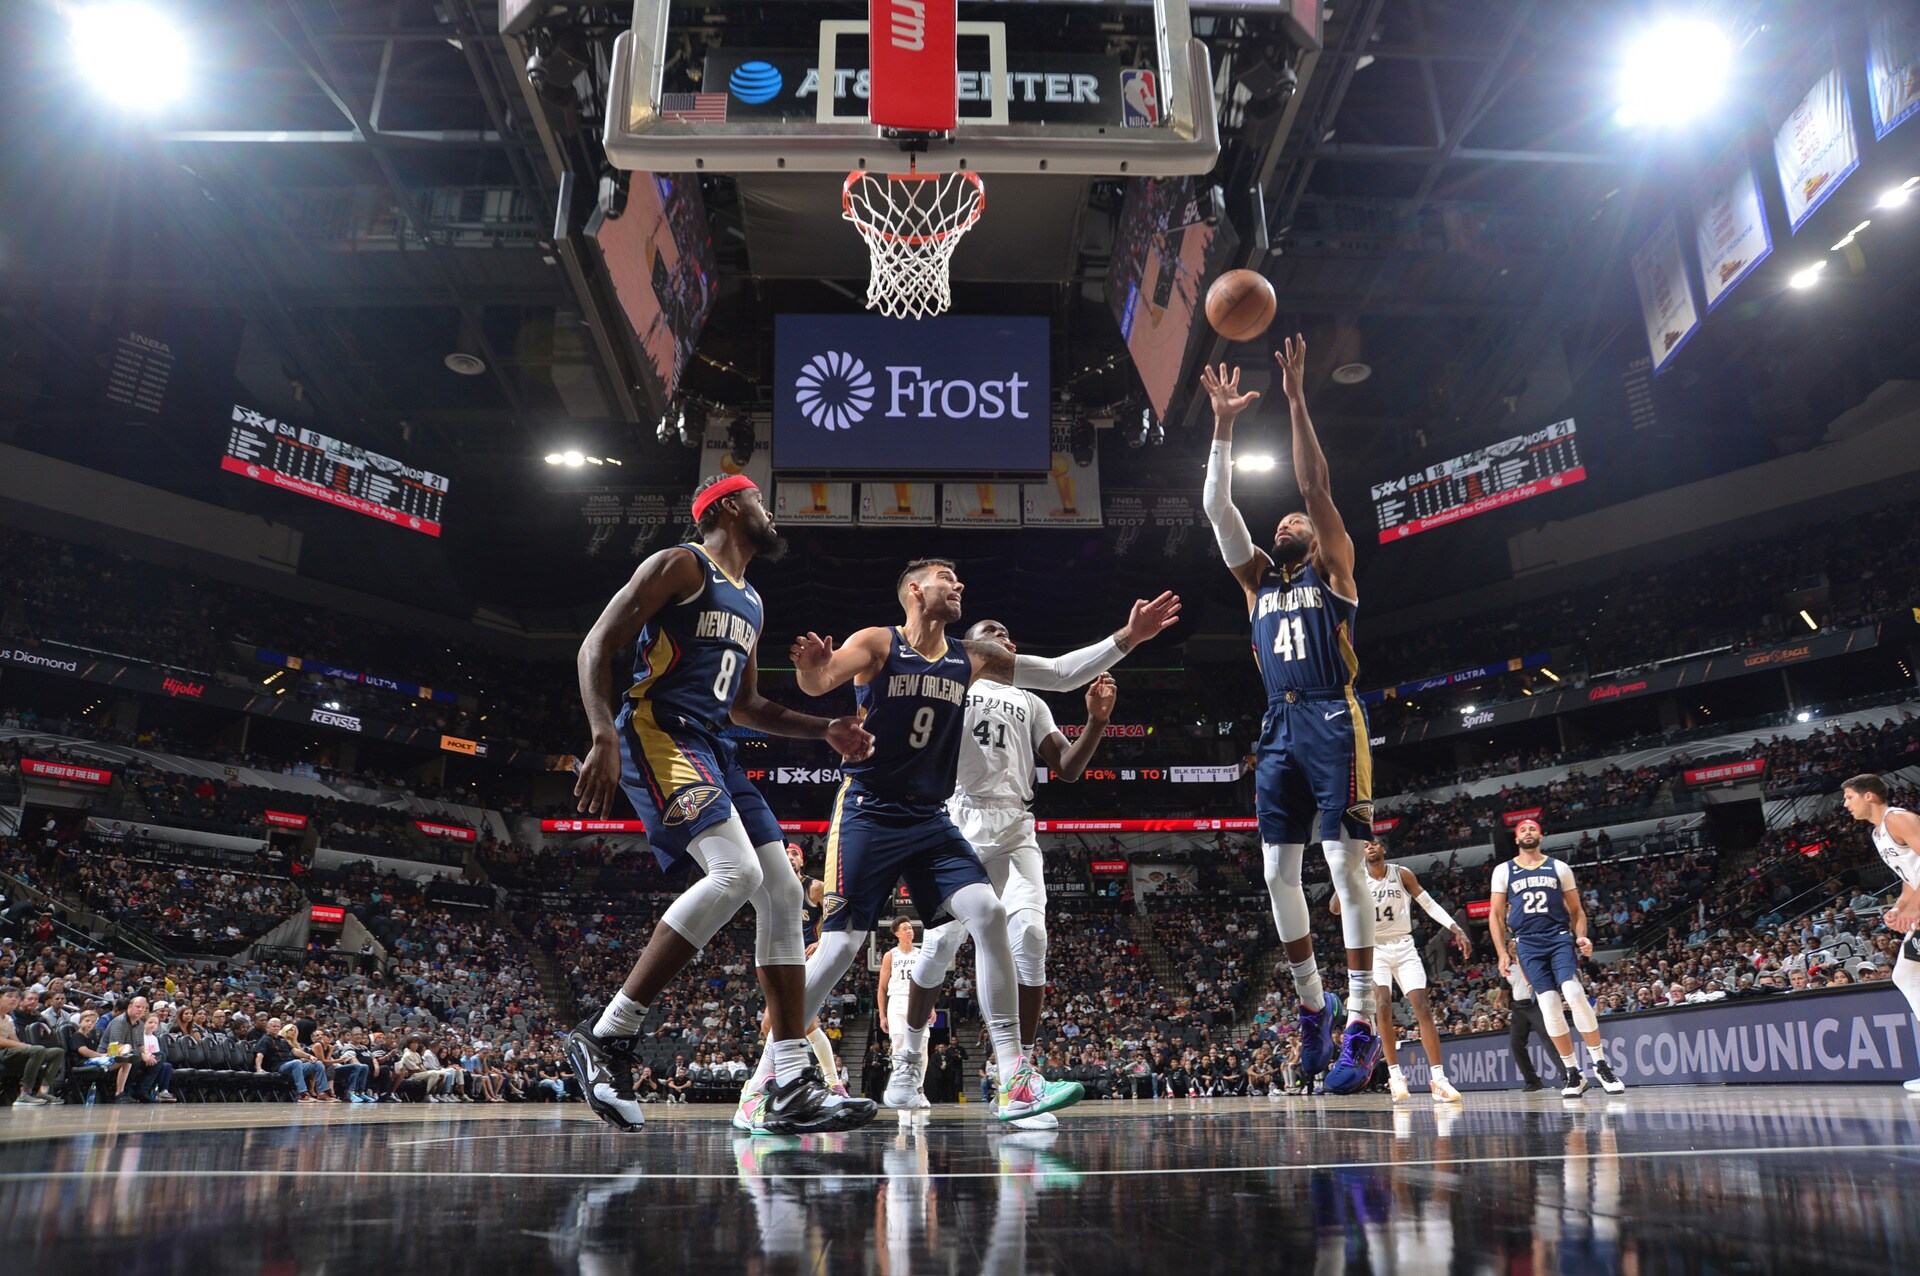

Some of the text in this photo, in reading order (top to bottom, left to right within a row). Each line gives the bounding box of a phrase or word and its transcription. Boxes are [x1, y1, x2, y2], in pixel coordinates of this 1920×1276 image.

[796, 68, 1100, 103] AT& ENTER
[885, 366, 1029, 419] Frost
[278, 422, 319, 446] SA 18
[706, 440, 769, 449] CHANS
[1523, 423, 1568, 446] NOP 21
[401, 466, 442, 488] NOP 21
[1409, 473, 1424, 485] SA
[274, 475, 318, 495] Download
[319, 486, 333, 500] the
[380, 508, 397, 522] App
[1421, 510, 1459, 528] Download
[1460, 504, 1474, 516] the
[1522, 485, 1537, 499] App
[587, 516, 620, 525] 1999
[628, 516, 666, 525] 2003
[1108, 518, 1146, 526] 2007
[1156, 518, 1194, 526] 2013
[696, 611, 756, 656] NEW ORLEA
[1273, 616, 1306, 662] 41
[14, 650, 77, 672] Diamond
[1744, 655, 1770, 667] LUCKY
[1783, 646, 1809, 658] EAGLE
[713, 649, 736, 701] 8
[1454, 668, 1486, 682] ULTRA
[888, 674, 965, 706] NEW ORLEANS
[909, 707, 935, 748] 9
[1462, 711, 1495, 729] Sprite
[447, 740, 472, 750] HOLT
[972, 720, 1006, 749] 41
[33, 764, 100, 780] THE HEART OF THE FAN
[747, 769, 842, 782] PF 3 SA
[1085, 770, 1116, 780] FG%
[1141, 770, 1159, 780] TO
[1162, 769, 1168, 780] 7
[1695, 772, 1706, 780] THE
[1511, 876, 1558, 894] NEW ORLEANS
[1522, 891, 1549, 914] 22
[1375, 906, 1394, 922] 14
[1450, 1049, 1509, 1084] SMART
